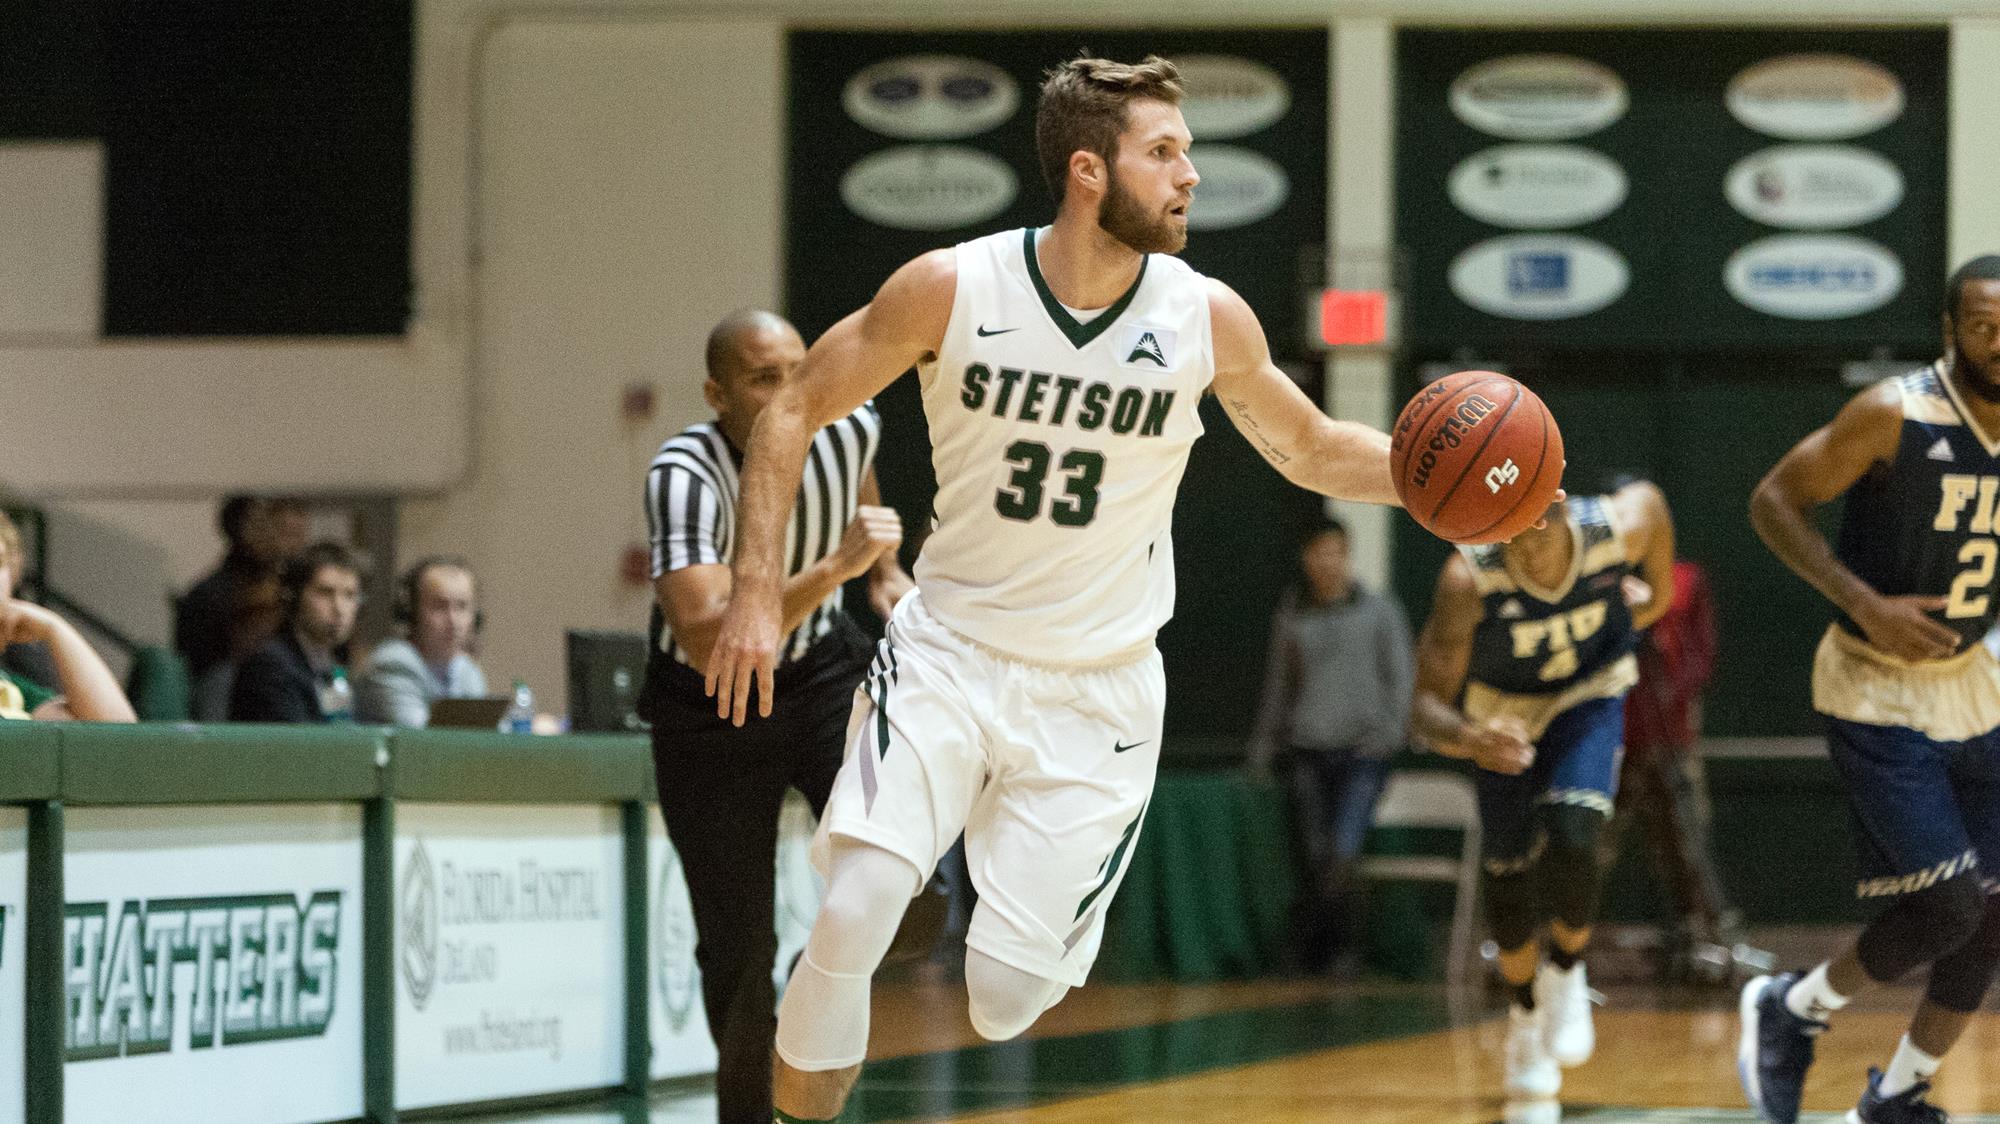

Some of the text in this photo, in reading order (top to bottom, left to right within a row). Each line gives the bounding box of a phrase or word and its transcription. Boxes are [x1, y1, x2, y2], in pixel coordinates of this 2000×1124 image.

[960, 361, 1178, 438] STETSON
[1411, 393, 1498, 488] Wilson
[993, 438, 1107, 529] 33
[1933, 473, 2000, 537] FI
[1946, 538, 1998, 619] 2
[1510, 598, 1608, 658] FIU
[63, 889, 343, 1063] HATTERS
